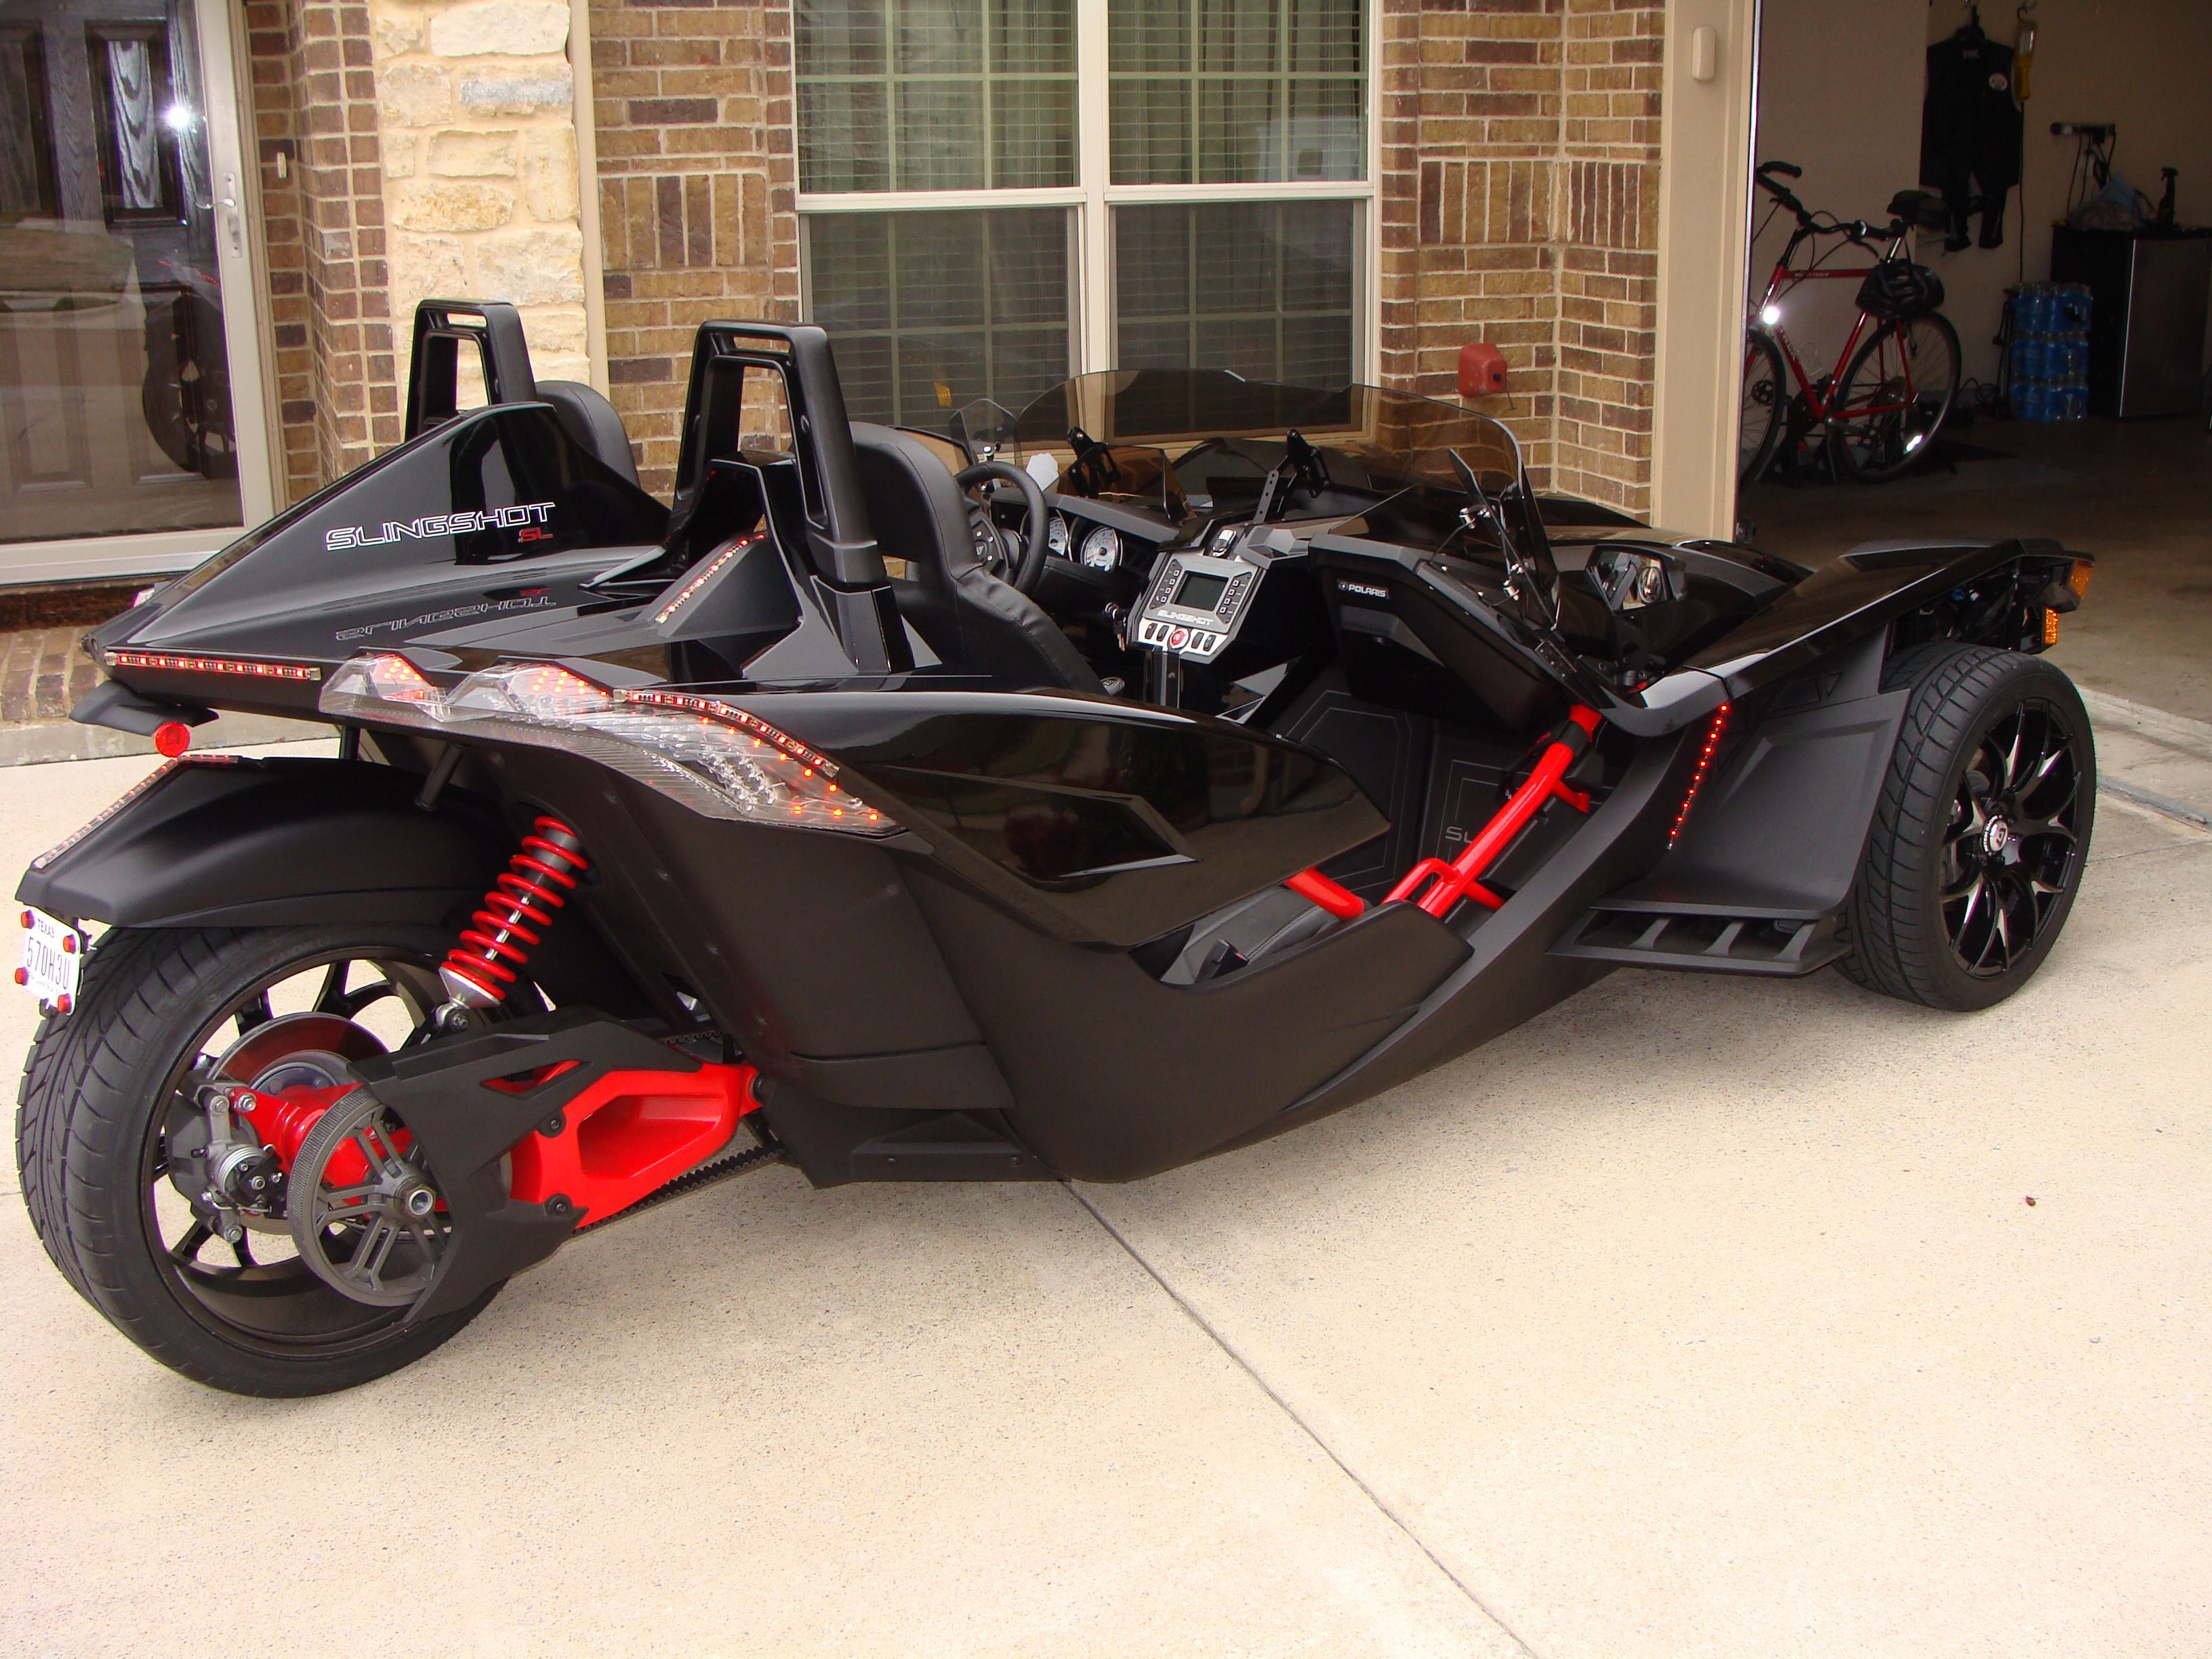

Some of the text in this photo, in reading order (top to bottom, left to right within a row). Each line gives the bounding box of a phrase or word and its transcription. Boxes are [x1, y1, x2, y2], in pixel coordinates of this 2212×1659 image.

[325, 501, 556, 551] SLINGSHOT
[520, 528, 554, 542] SL
[1348, 583, 1387, 597] POLARIS
[37, 918, 55, 939] TEXAS
